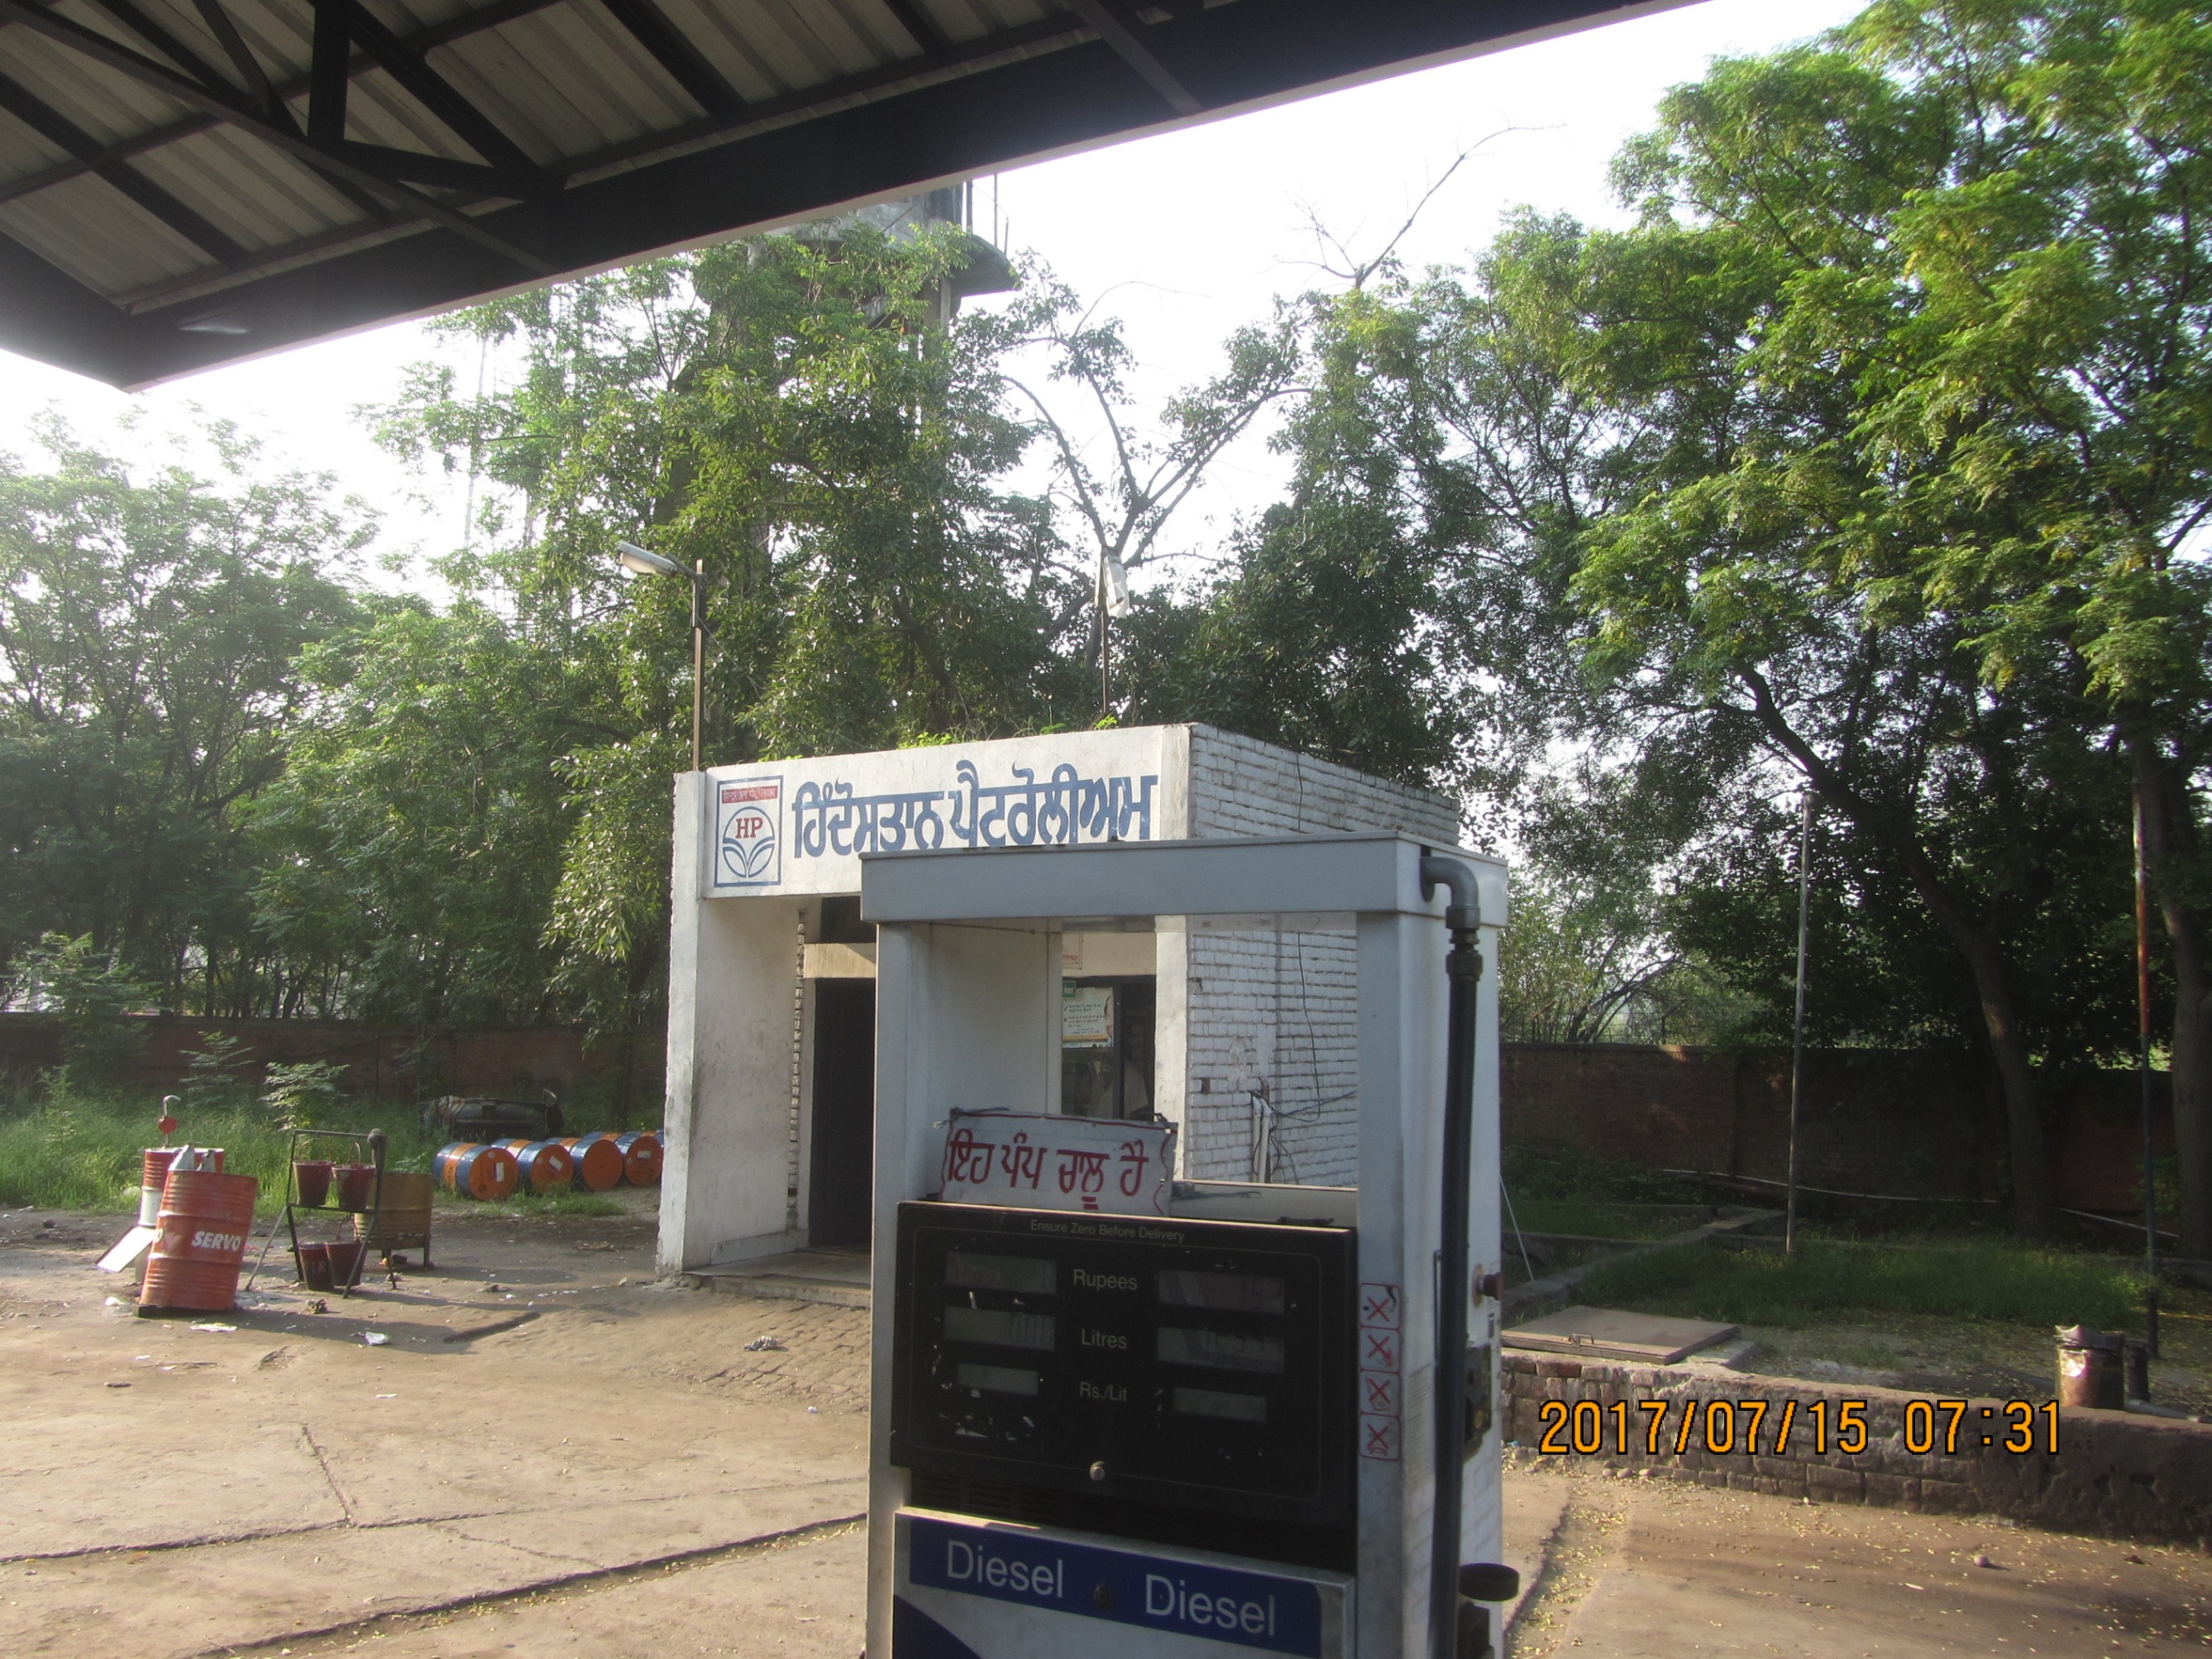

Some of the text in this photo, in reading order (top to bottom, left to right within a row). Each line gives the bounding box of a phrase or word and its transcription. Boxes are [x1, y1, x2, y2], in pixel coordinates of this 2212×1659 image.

[948, 759, 1159, 848] ਪੈਟਰੋਲੀਅਮ
[734, 816, 764, 839] HP
[948, 1128, 996, 1183] ਇਹ
[1001, 1131, 1048, 1188] ਪੰਪ
[1119, 1139, 1150, 1196] ਹੈ
[191, 1230, 241, 1251] SERVO
[1030, 1219, 1185, 1243] Ensure Zero Before Delivery
[1073, 1268, 1138, 1293] Rupees
[1081, 1327, 1128, 1350] Litres
[1079, 1381, 1128, 1403] Rs./Lit
[948, 1539, 1275, 1637] Diesel Diesel
